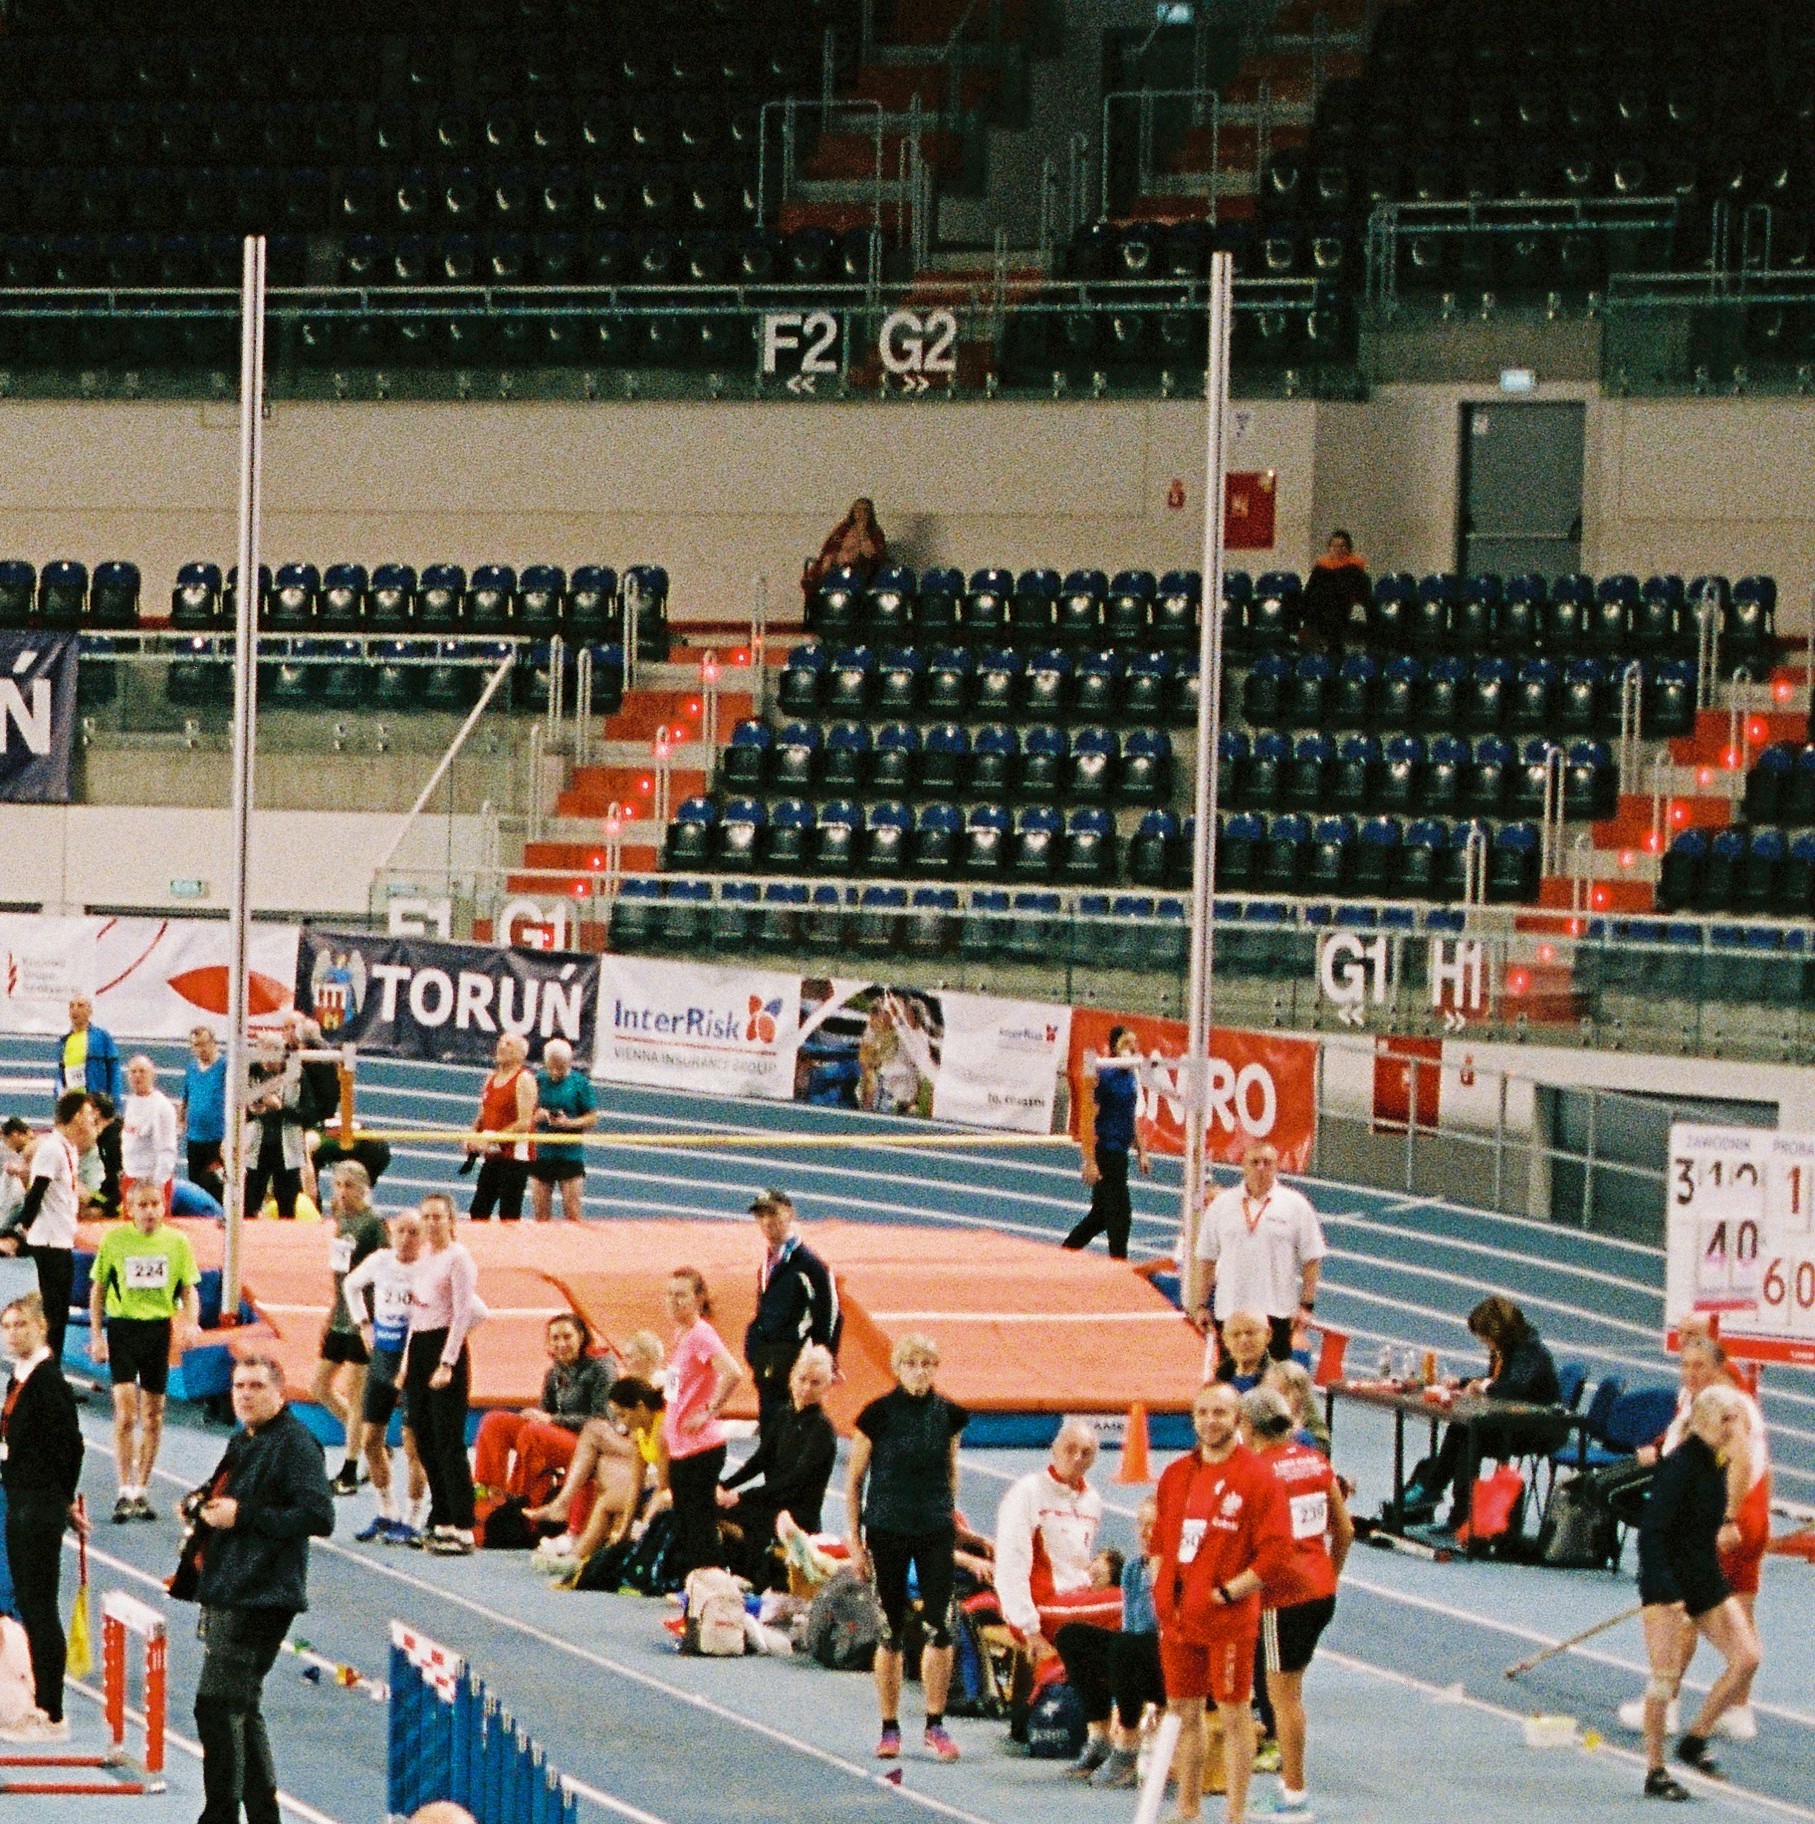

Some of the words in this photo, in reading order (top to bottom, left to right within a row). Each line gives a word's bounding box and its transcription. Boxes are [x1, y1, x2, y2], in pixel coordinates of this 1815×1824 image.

[764, 312, 839, 373] F2
[878, 310, 958, 374] G2
[372, 963, 583, 1041] TORUŃ
[1320, 935, 1389, 1003] G1
[1431, 938, 1483, 1010] H1
[614, 998, 741, 1041] InterRisk
